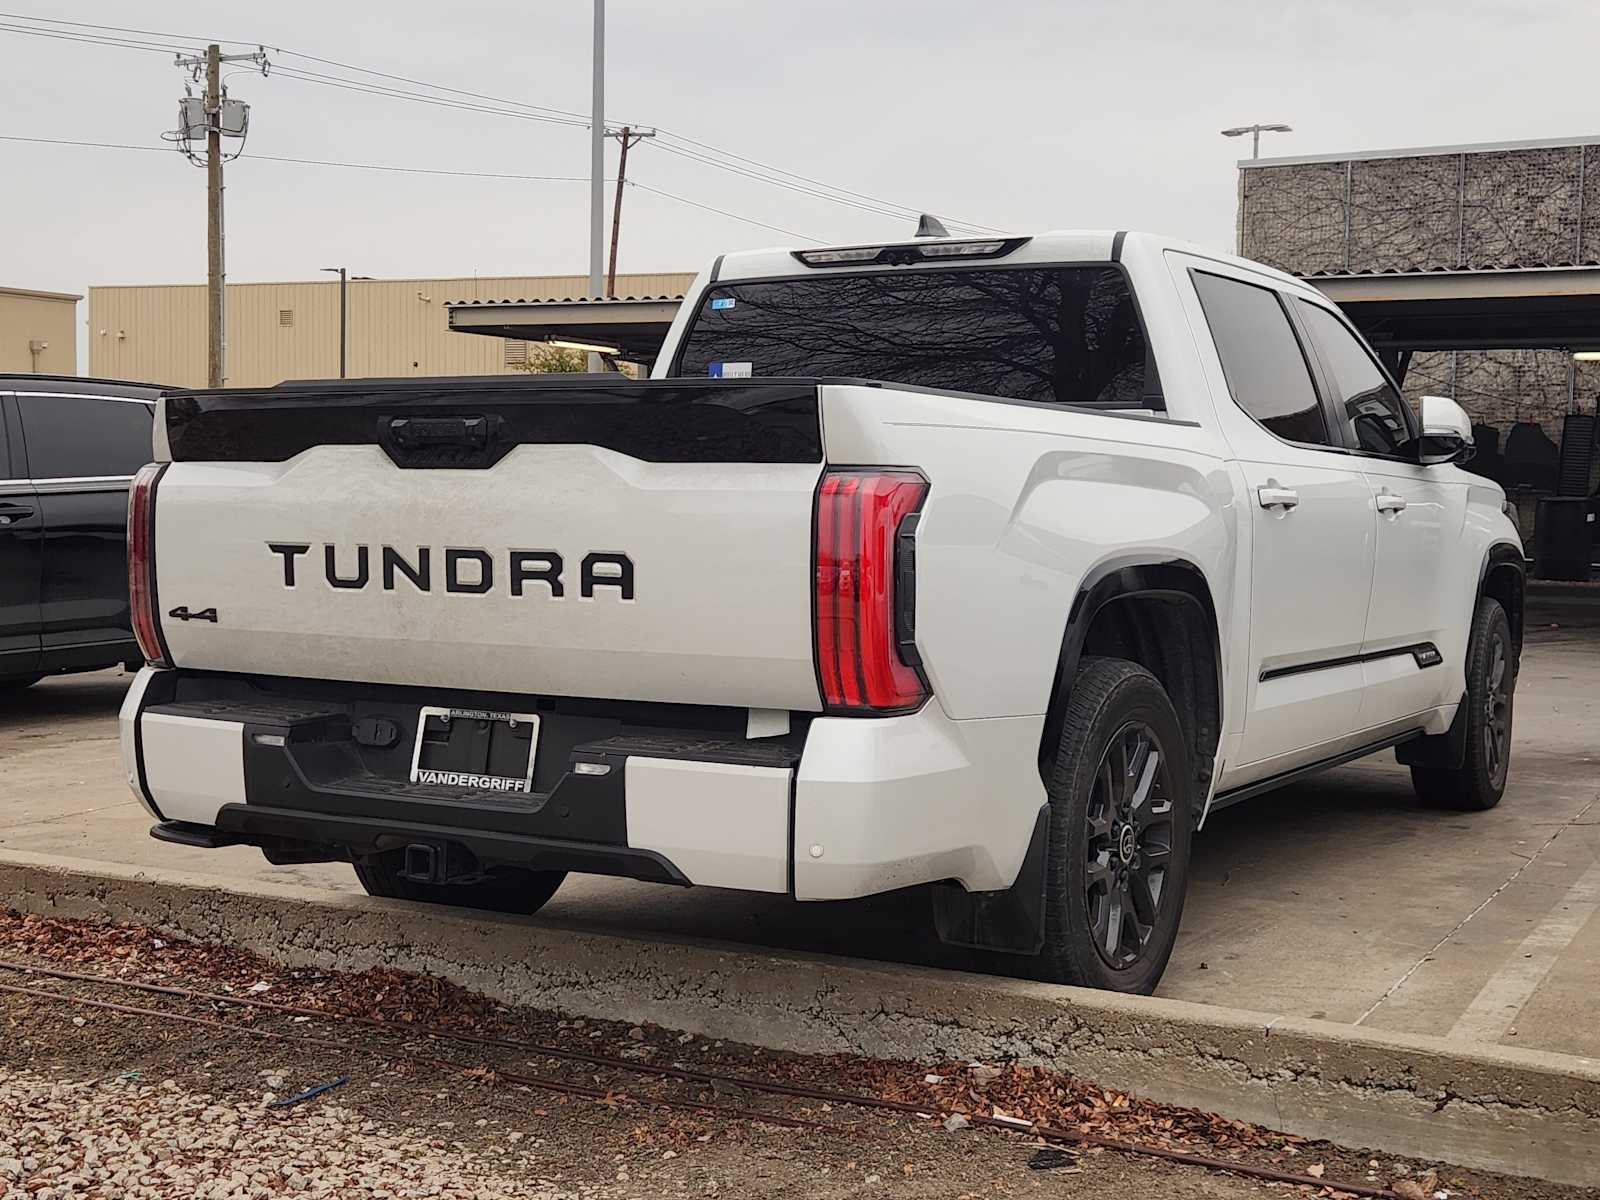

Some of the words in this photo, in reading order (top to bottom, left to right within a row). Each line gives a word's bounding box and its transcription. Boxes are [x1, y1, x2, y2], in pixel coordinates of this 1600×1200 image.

[267, 543, 635, 600] TUNDRA
[490, 711, 511, 720] TEXAS
[418, 771, 525, 792] VANDERGRIFF
